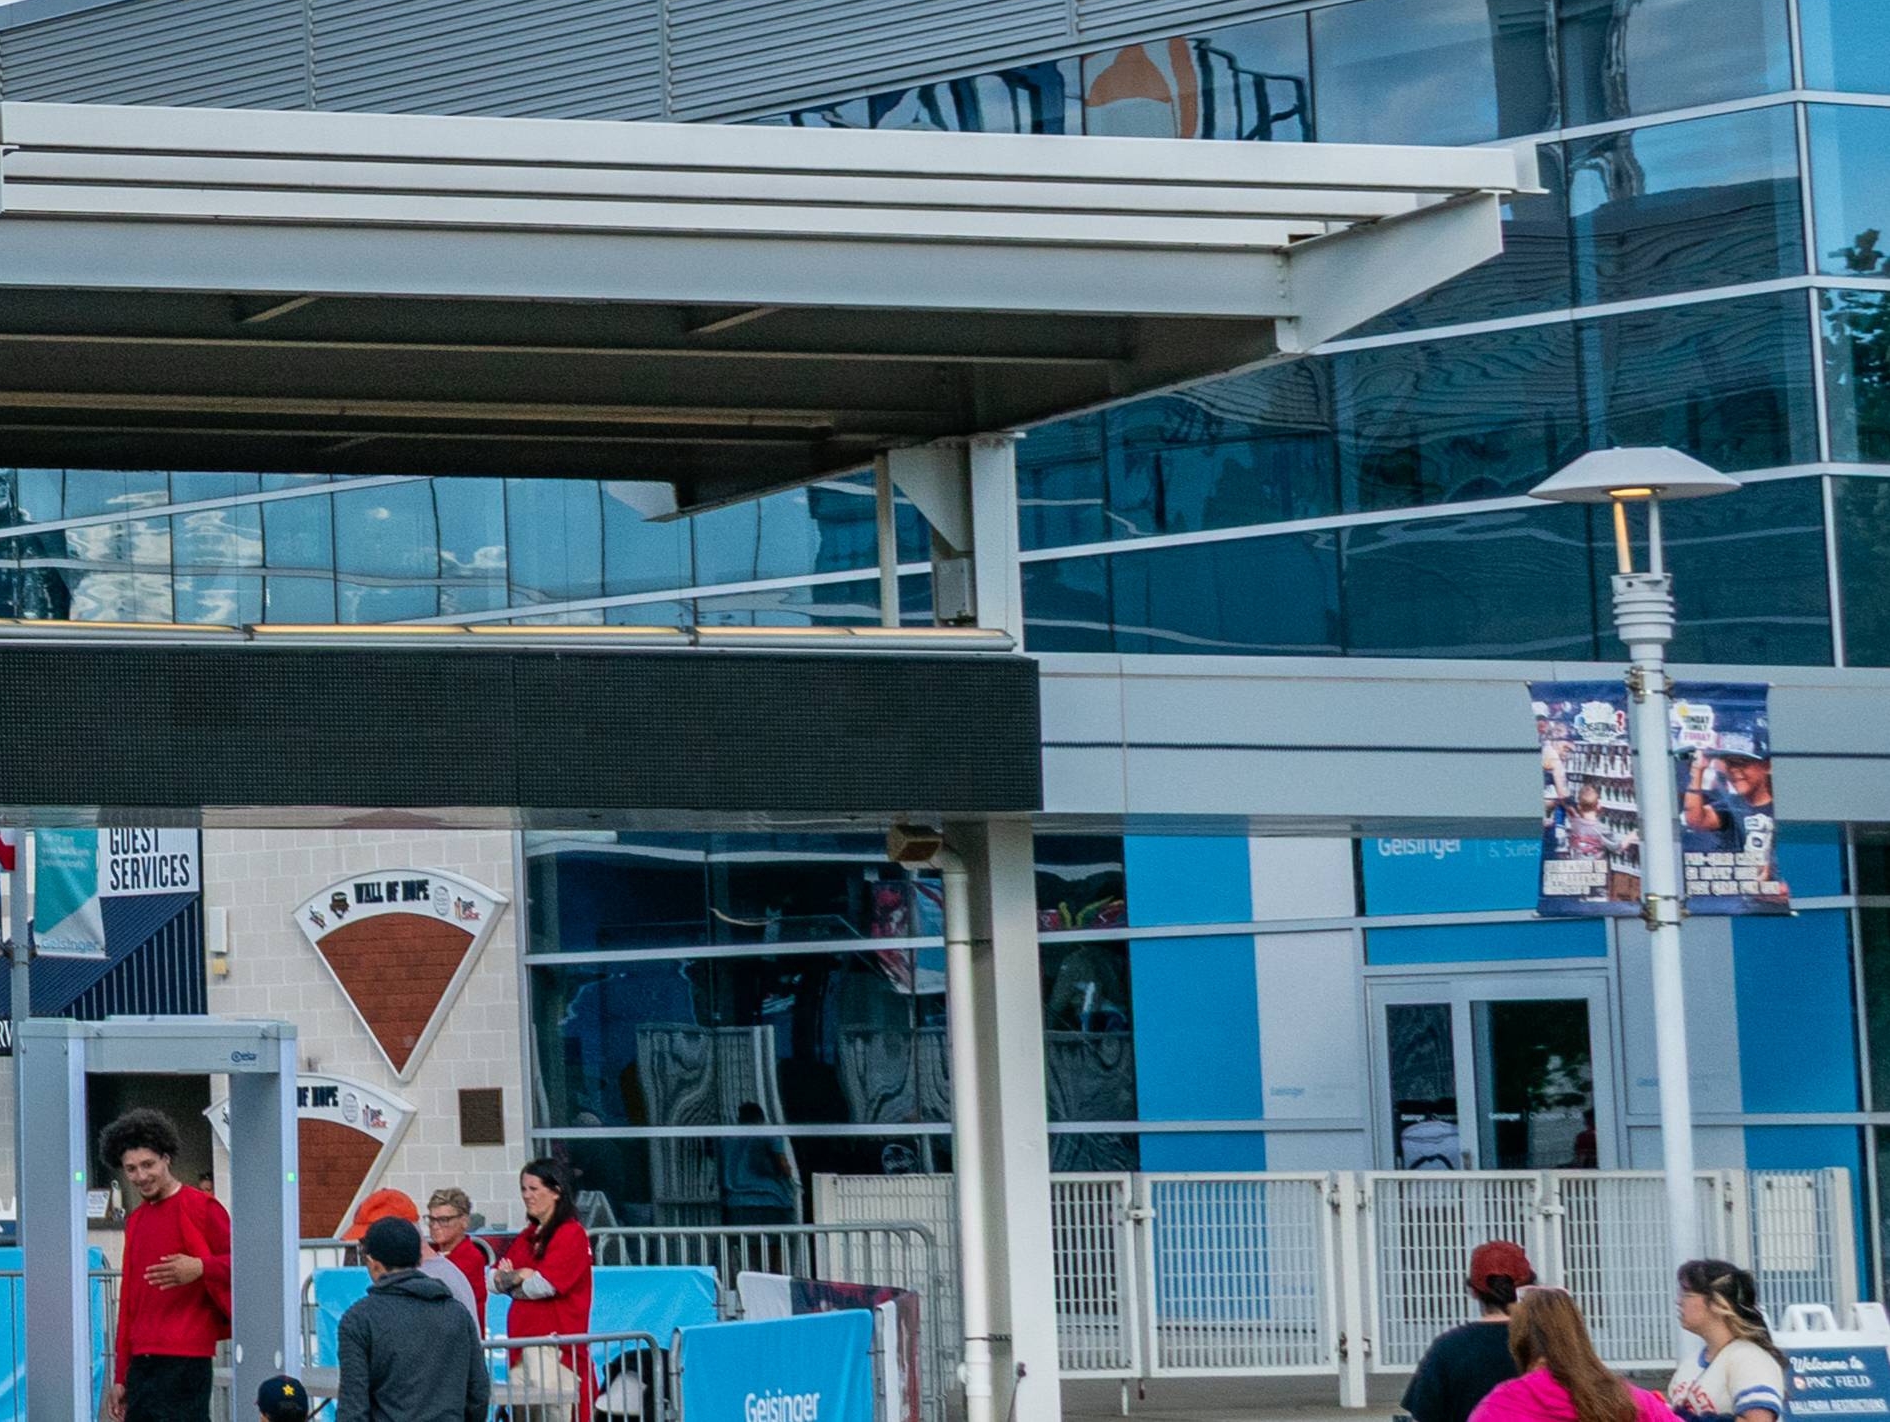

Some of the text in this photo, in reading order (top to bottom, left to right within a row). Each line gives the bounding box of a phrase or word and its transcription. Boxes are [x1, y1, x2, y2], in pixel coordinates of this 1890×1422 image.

[109, 829, 159, 855] GUEST
[109, 853, 190, 891] SERVICES
[353, 879, 430, 904] WALL OF HOPE
[311, 1086, 339, 1108] HOPE
[1789, 1354, 1865, 1373] Welcome to
[1806, 1374, 1871, 1388] PNC FIELD
[744, 1388, 821, 1422] Geisinger
